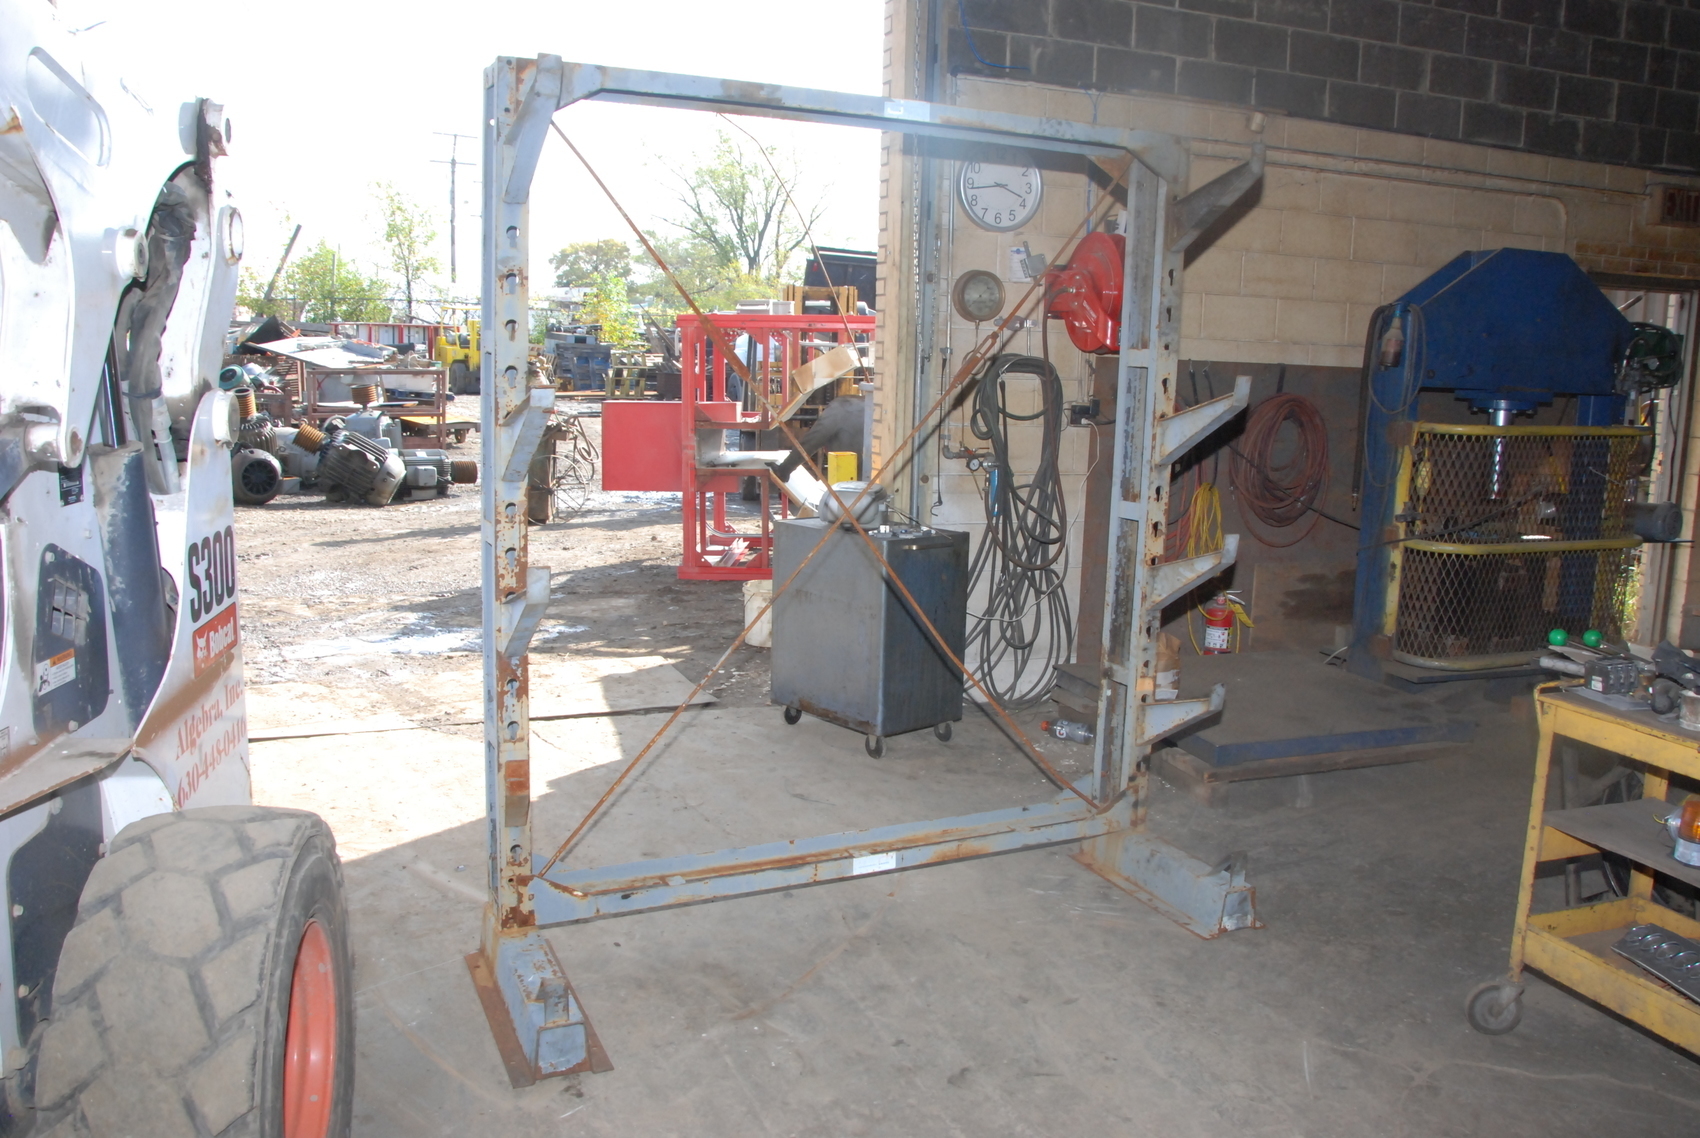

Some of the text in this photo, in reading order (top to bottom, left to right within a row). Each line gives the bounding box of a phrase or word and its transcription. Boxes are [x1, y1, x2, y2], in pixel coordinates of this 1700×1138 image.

[970, 161, 981, 174] 10
[1021, 165, 1029, 177] 2
[966, 177, 975, 189] 9
[1024, 182, 1032, 195] 3
[970, 194, 978, 207] 8
[1019, 197, 1027, 210] 4
[1664, 189, 1699, 221] EXIT
[980, 207, 988, 220] 7
[994, 212, 1002, 225] 6
[1008, 210, 1016, 222] 5
[188, 525, 236, 623] S300
[209, 616, 235, 658] Bobcat
[175, 680, 243, 761] Algebra, Inc.
[178, 714, 247, 808] 630-448-0416
